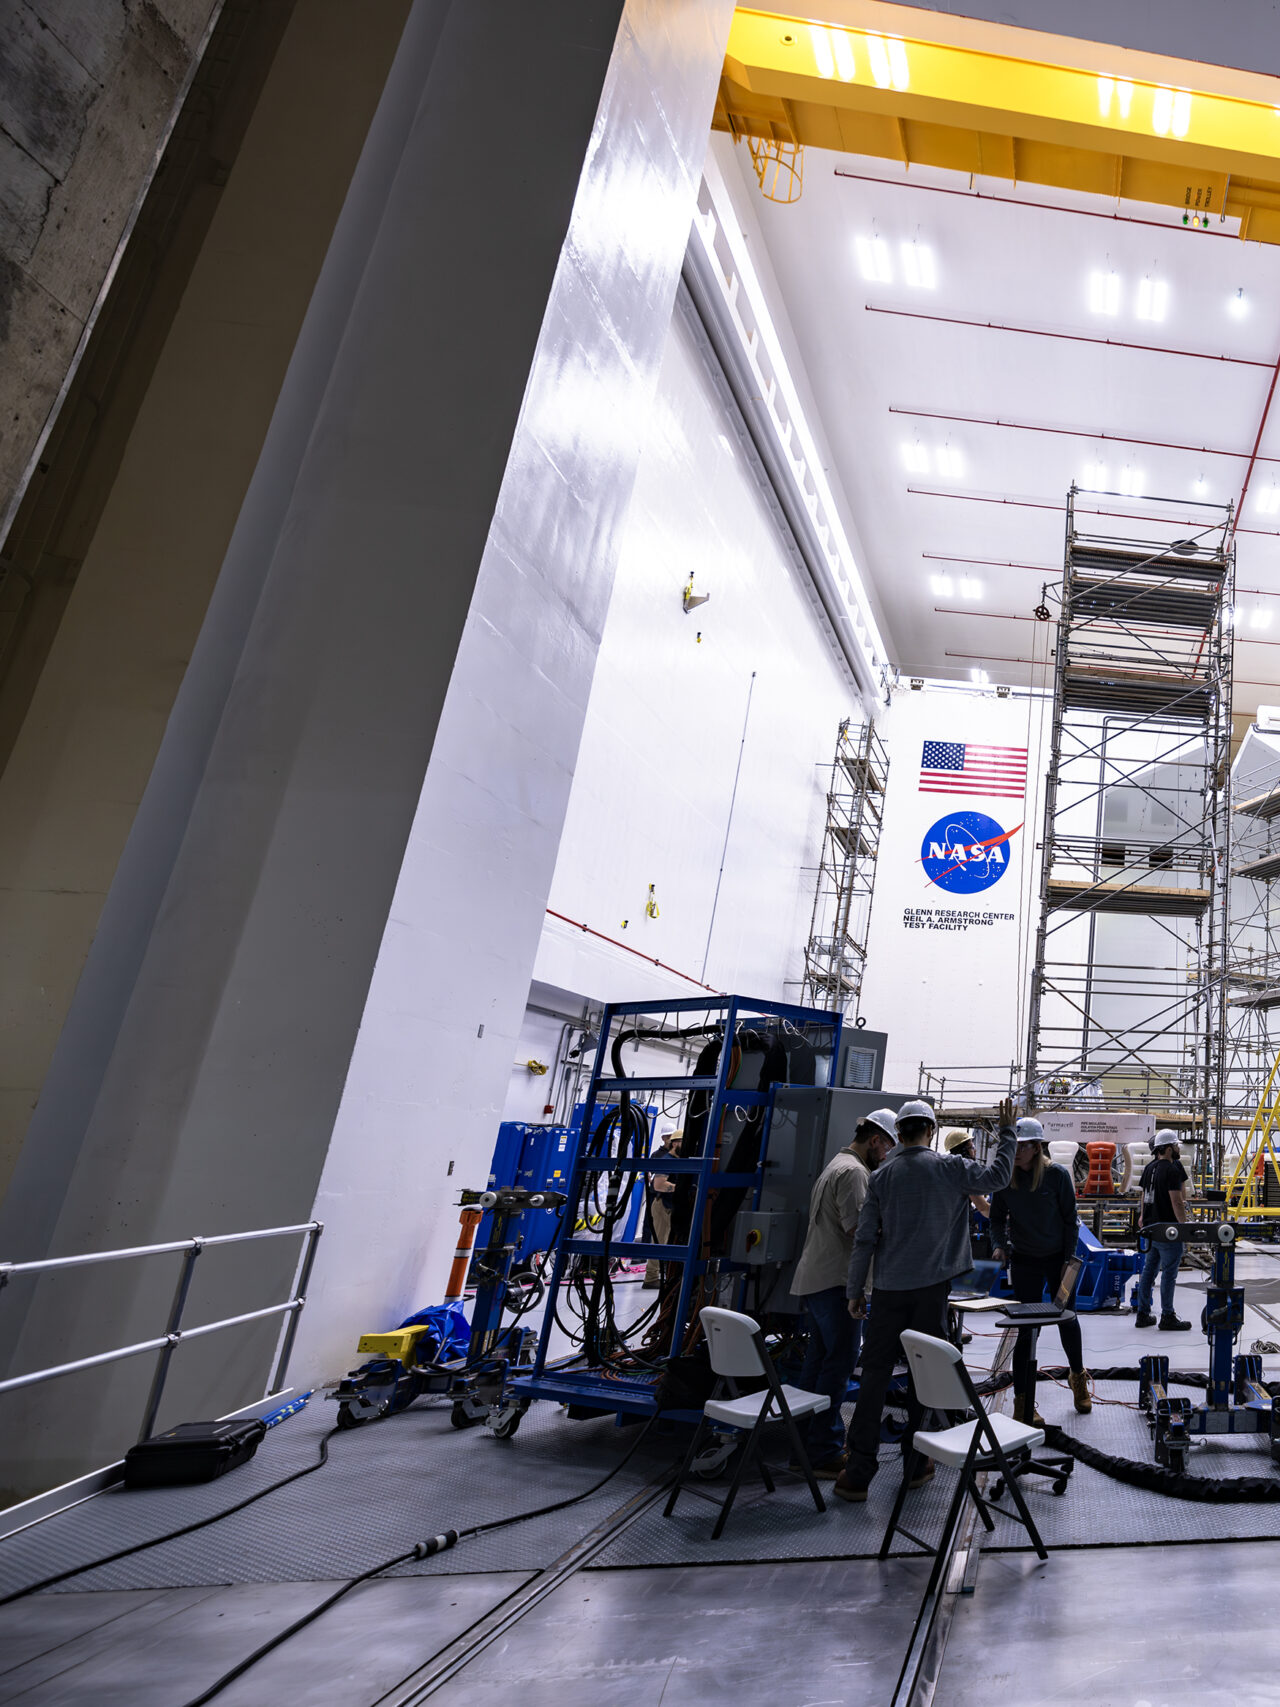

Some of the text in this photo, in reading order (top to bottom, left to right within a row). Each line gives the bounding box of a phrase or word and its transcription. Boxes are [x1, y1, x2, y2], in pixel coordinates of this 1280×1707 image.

[928, 842, 1005, 864] NASA
[904, 908, 1015, 920] GLENN RESEARCH CENTER
[938, 917, 994, 926] ARMSTRONG
[928, 923, 968, 931] FACILITY
